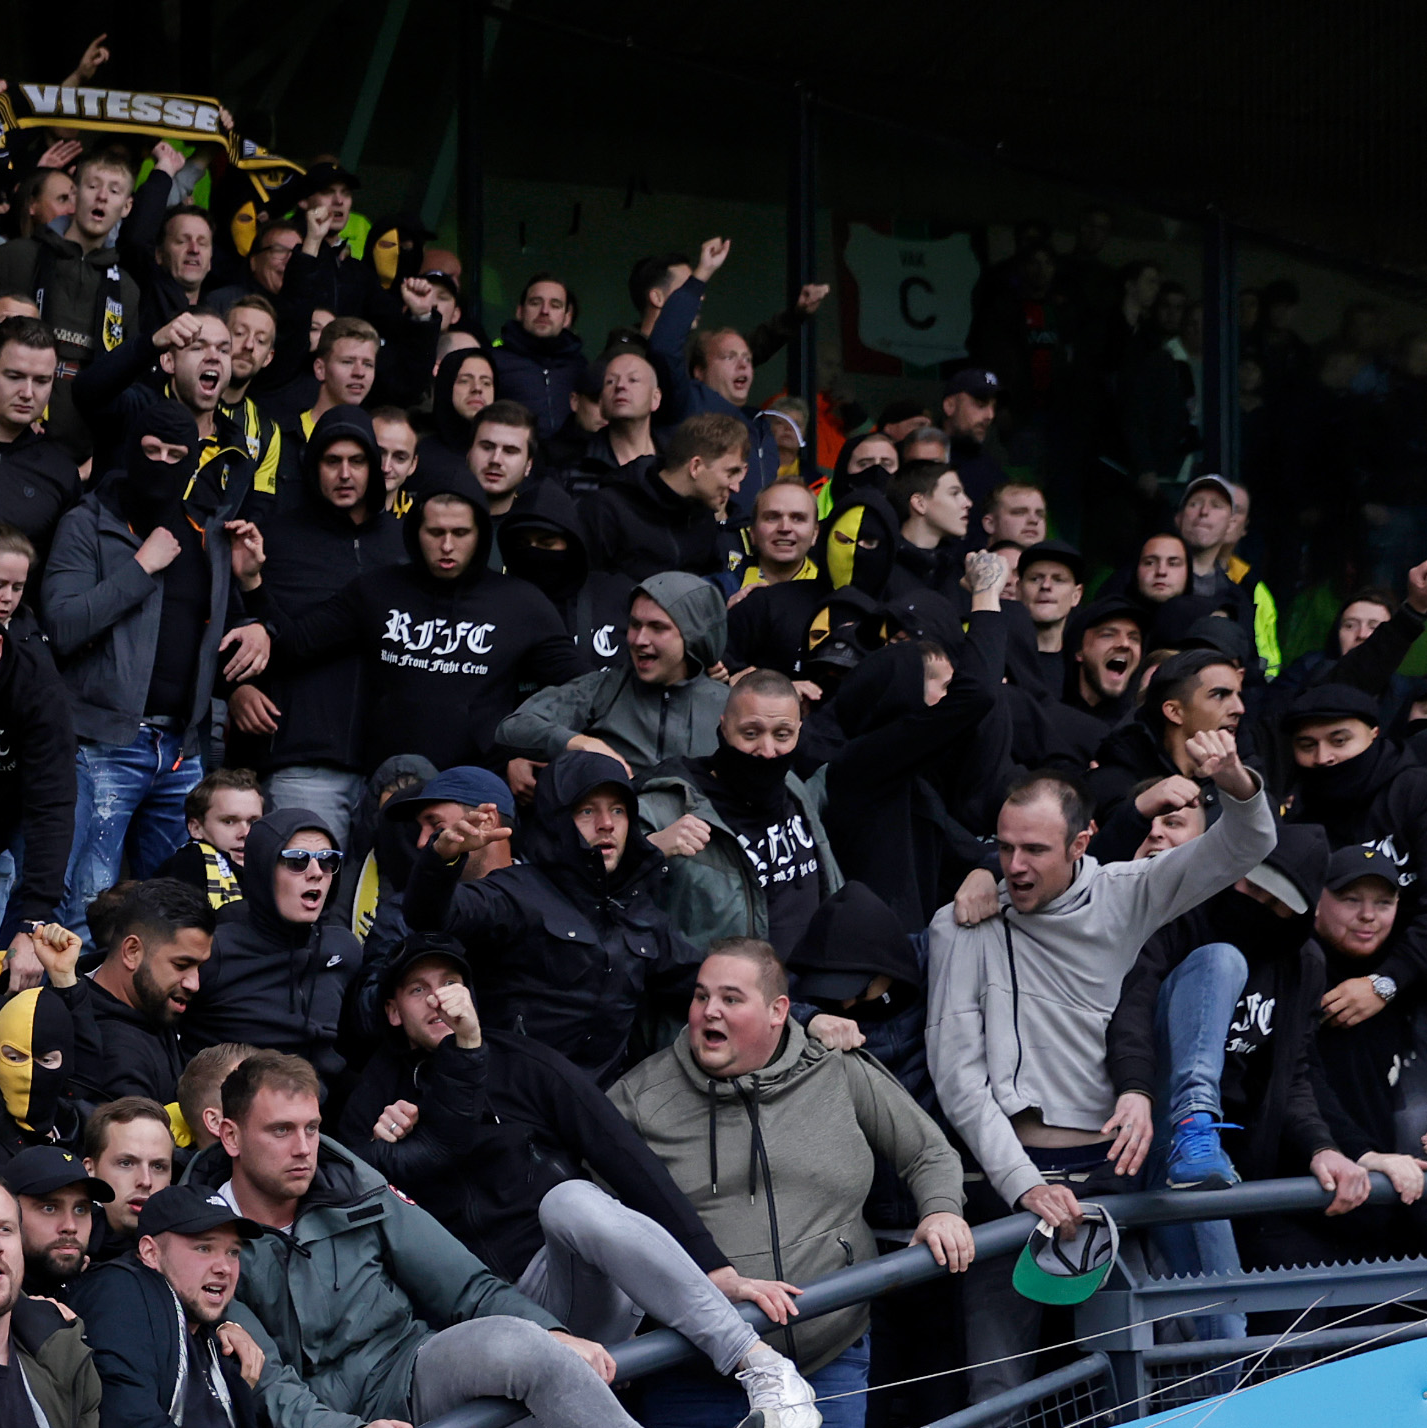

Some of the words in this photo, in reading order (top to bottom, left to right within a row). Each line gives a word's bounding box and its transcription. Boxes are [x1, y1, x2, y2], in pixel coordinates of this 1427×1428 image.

[22, 84, 221, 133] VITESSE
[900, 277, 936, 331] C
[398, 654, 429, 670] Front
[428, 659, 460, 675] Fight
[461, 662, 489, 676] Crew
